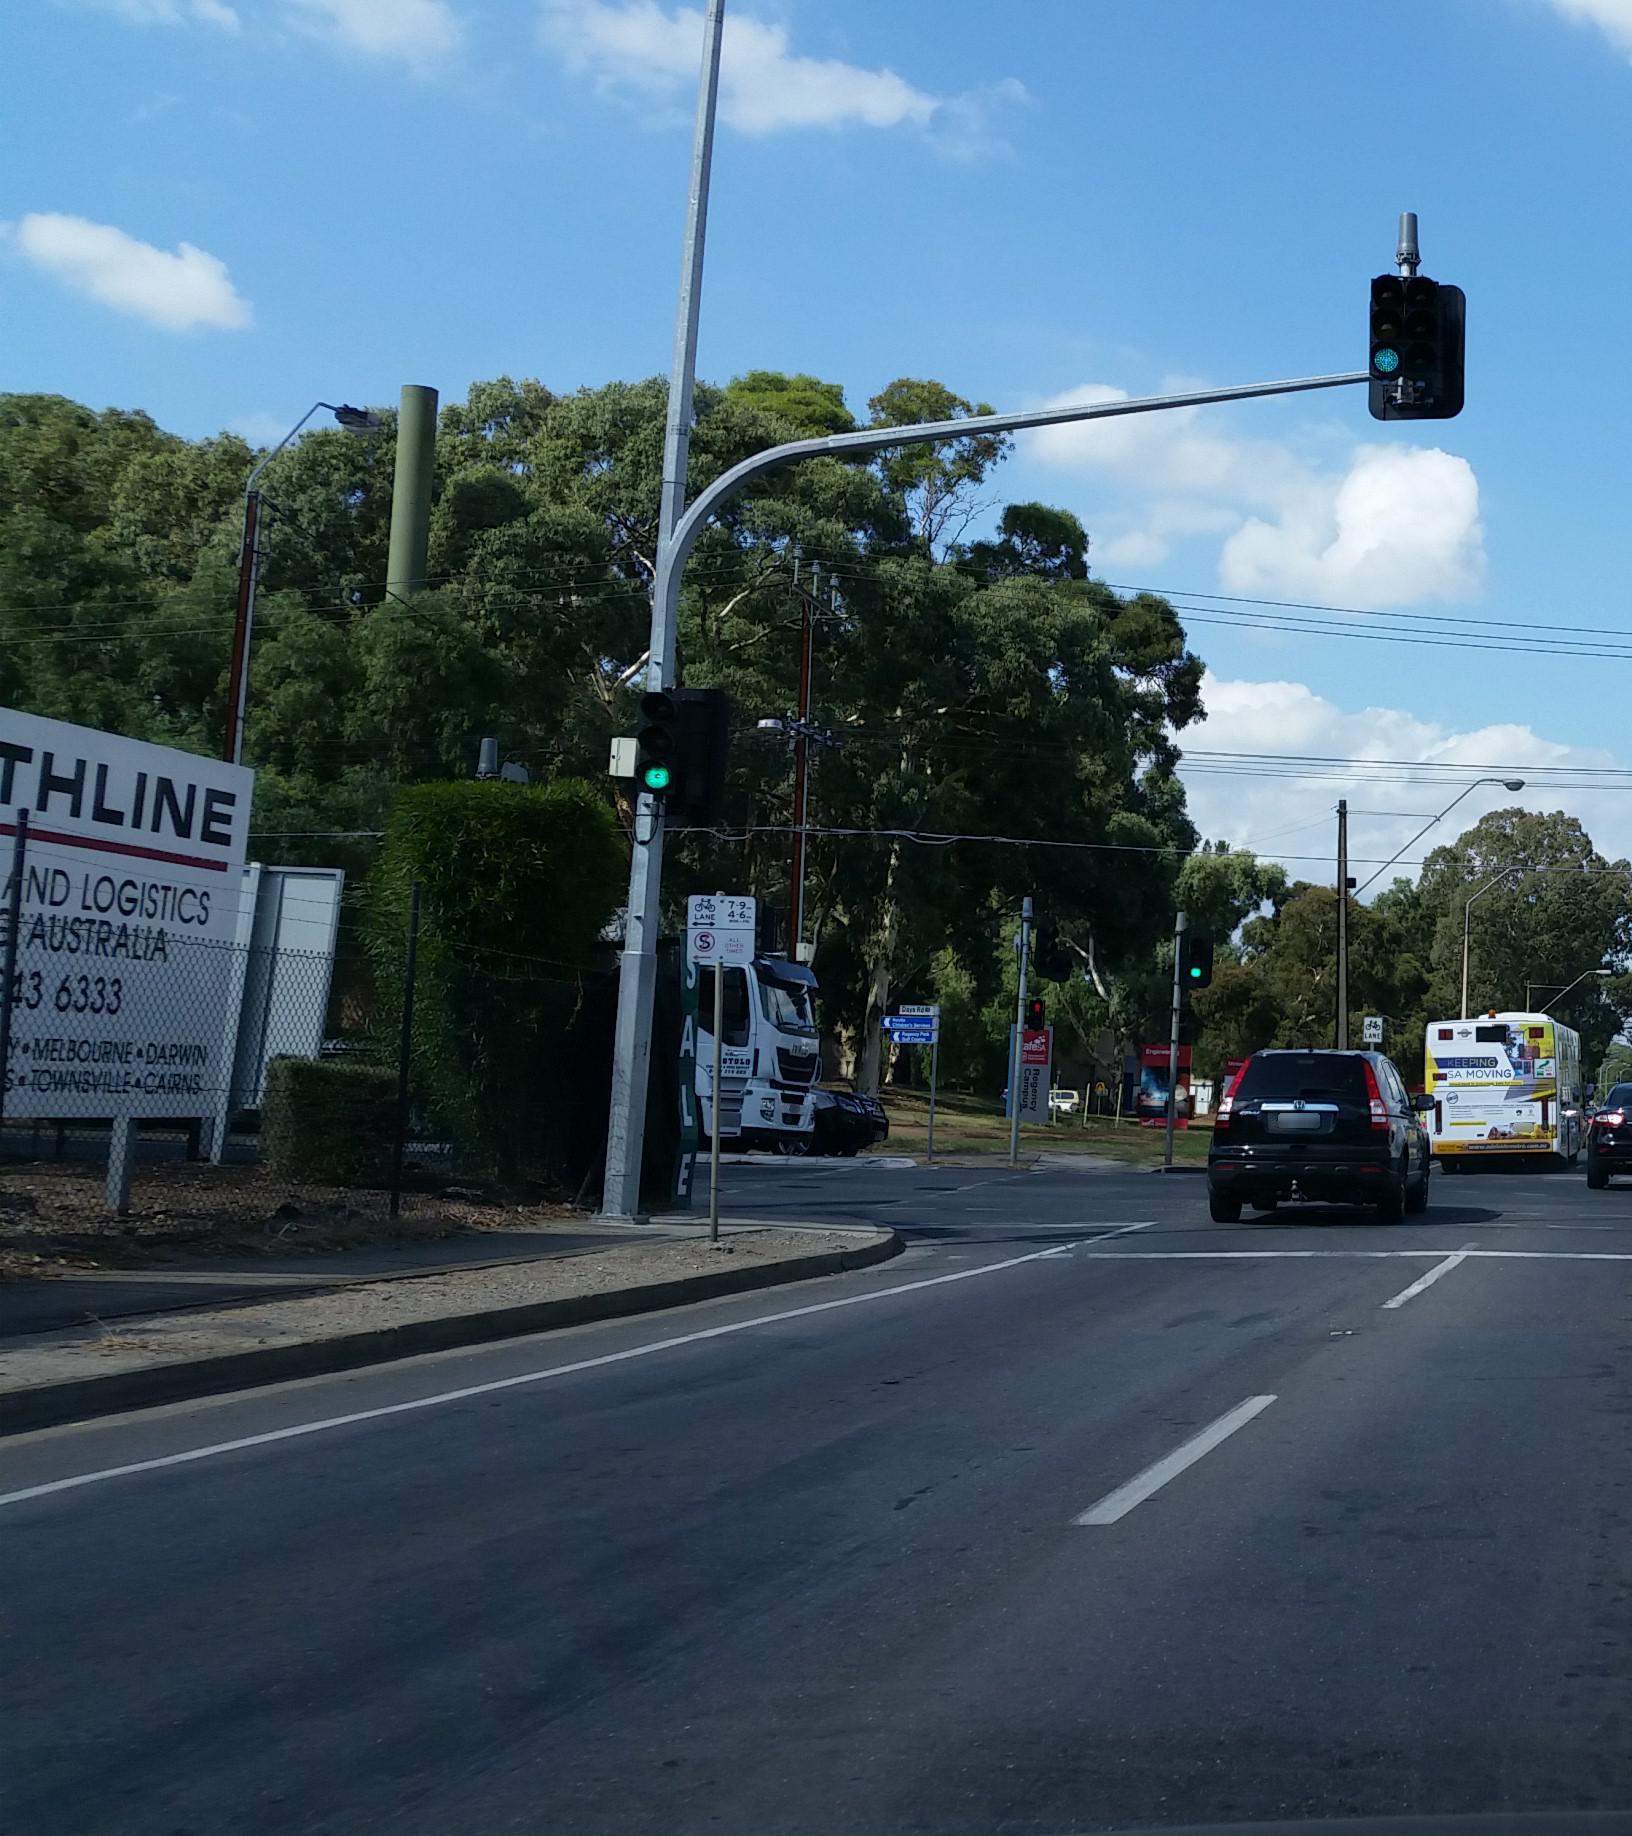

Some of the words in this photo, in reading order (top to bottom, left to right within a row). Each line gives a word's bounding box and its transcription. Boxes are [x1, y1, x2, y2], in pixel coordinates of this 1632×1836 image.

[0, 741, 236, 847] THLINE
[81, 873, 211, 926] LOGISTICS
[26, 912, 168, 963] AUSTRALIA
[55, 974, 122, 1015] 6333
[33, 1038, 133, 1064] MELBOURNE
[146, 1043, 207, 1066] DARWIN
[1023, 1042, 1046, 1051] afeSA
[1447, 1058, 1496, 1067] KEEPING
[31, 1069, 130, 1093] TOWNSVILLE
[145, 1072, 201, 1095] CAIRNS
[1021, 1068, 1031, 1109] Campus
[1030, 1068, 1040, 1112] Regency
[1447, 1070, 1463, 1079] SA
[1466, 1069, 1512, 1079] MOVING
